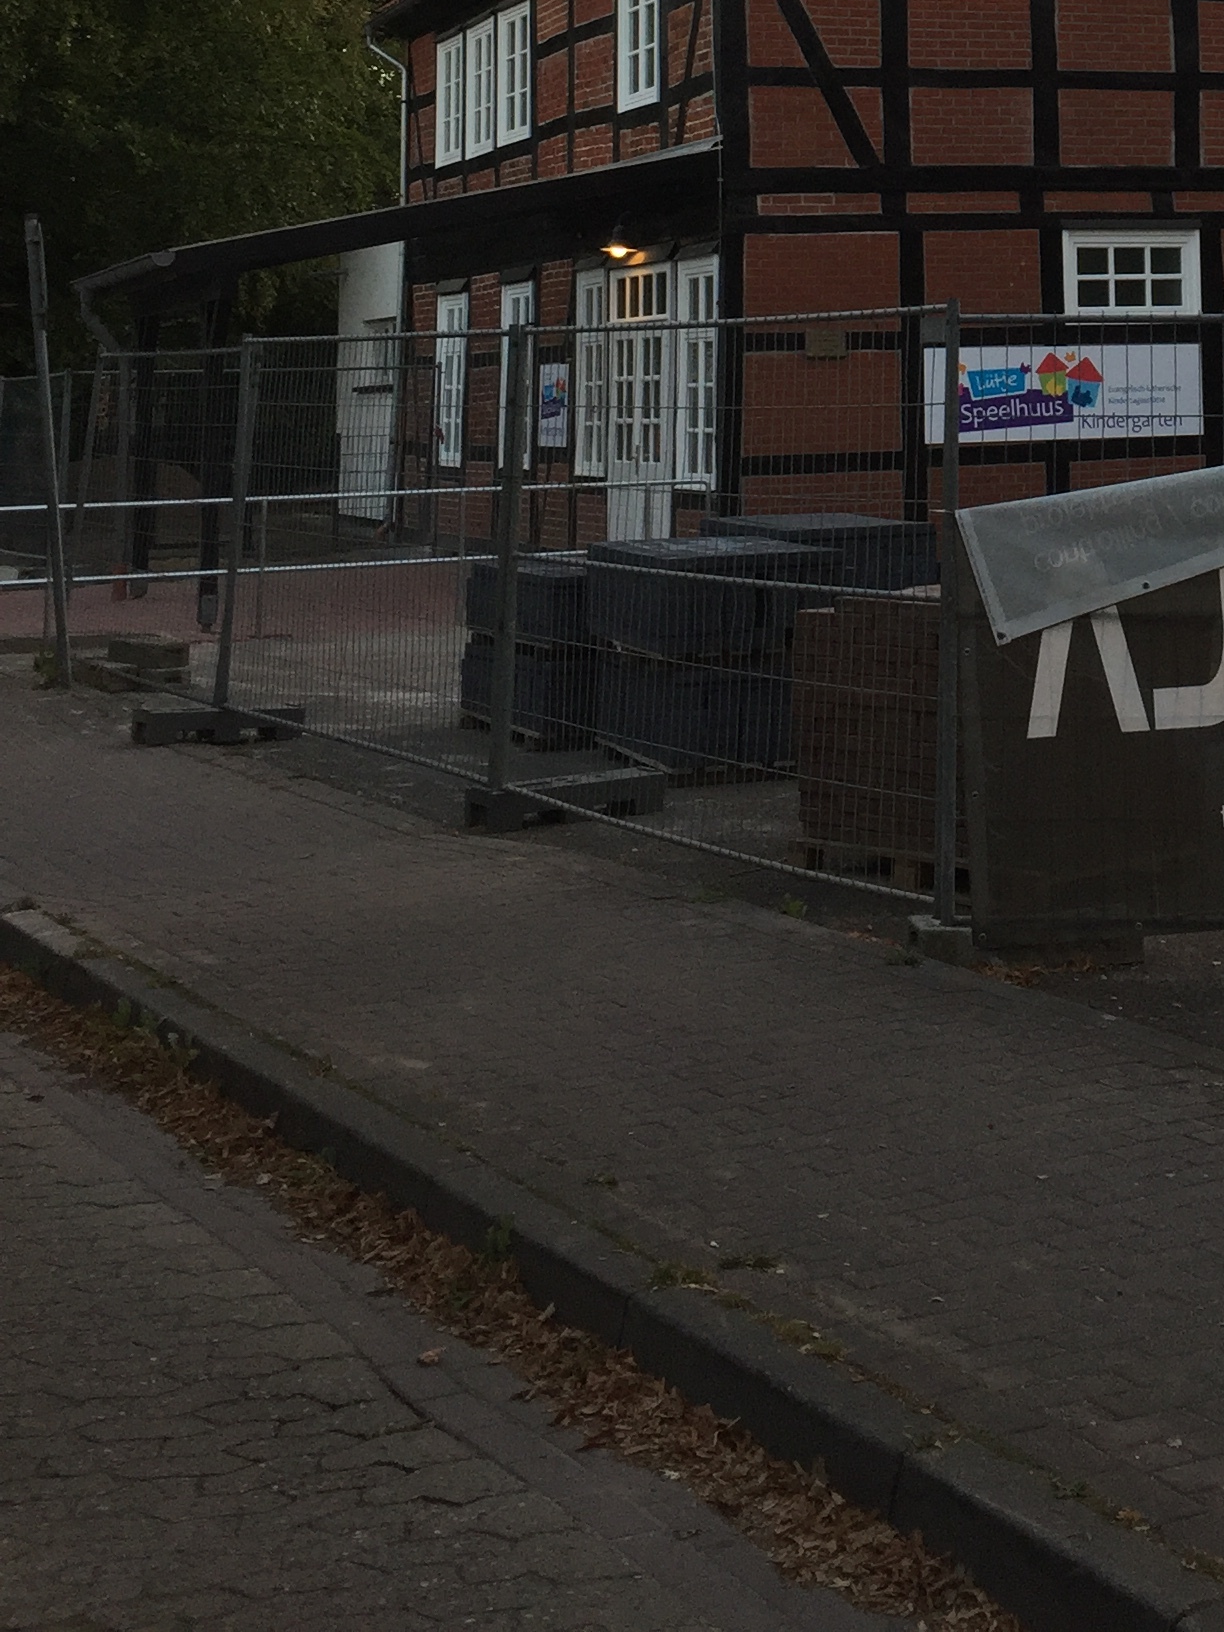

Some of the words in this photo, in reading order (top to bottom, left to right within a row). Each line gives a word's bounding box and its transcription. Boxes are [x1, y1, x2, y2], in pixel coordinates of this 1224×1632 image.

[976, 370, 1018, 391] Lütje
[959, 398, 1065, 428] Speelhuus
[1081, 413, 1183, 433] Kindergarten
